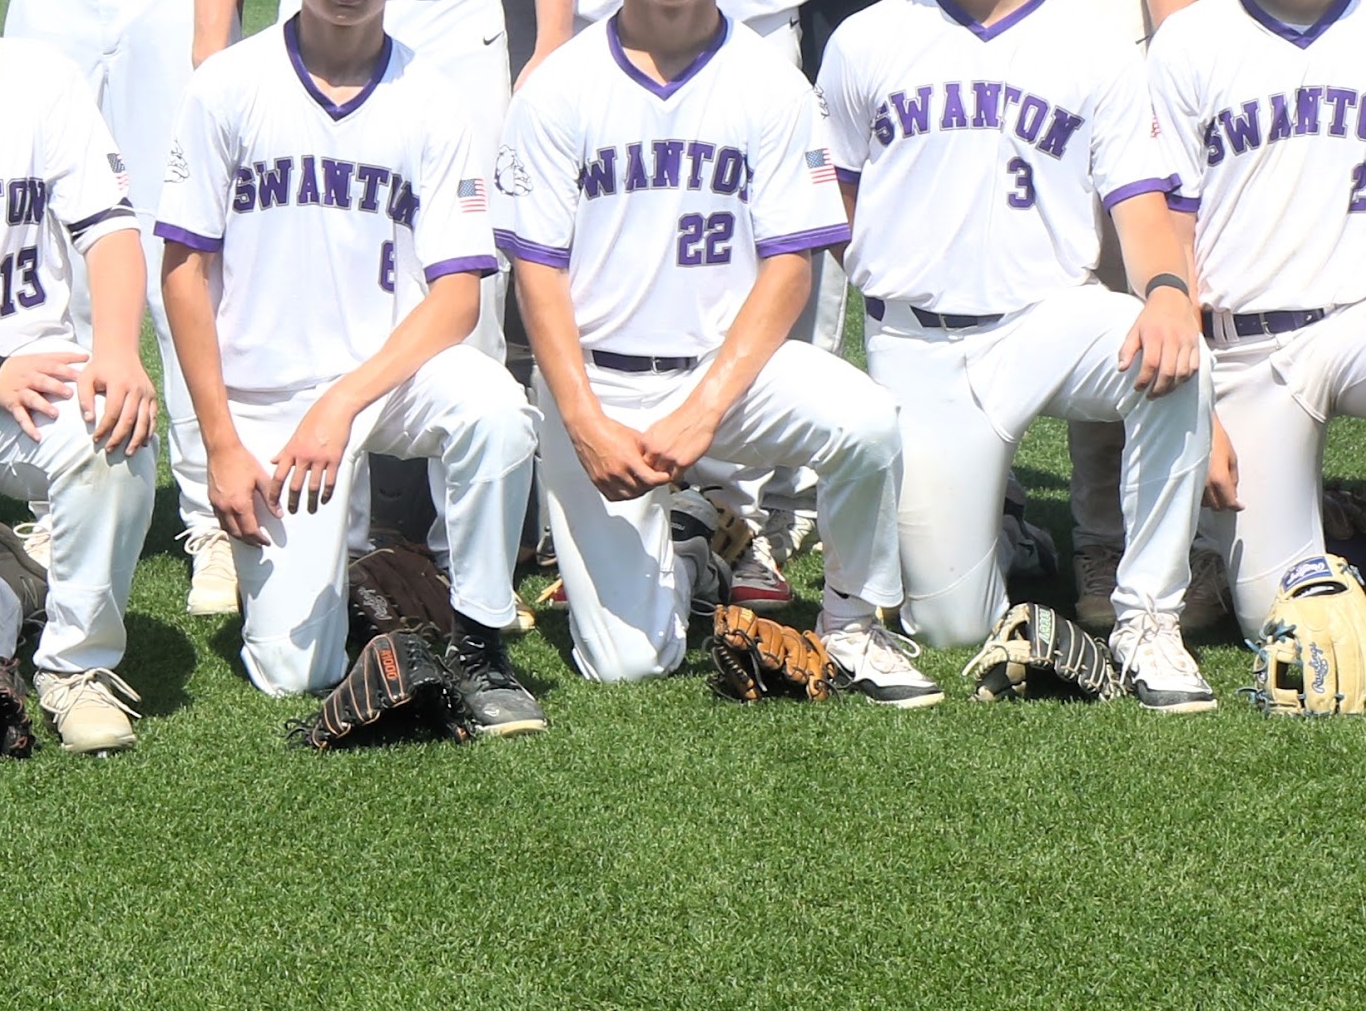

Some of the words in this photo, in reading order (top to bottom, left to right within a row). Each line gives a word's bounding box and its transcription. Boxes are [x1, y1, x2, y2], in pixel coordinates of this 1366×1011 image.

[578, 139, 753, 204] WANTO
[1005, 157, 1036, 211] 3
[676, 212, 736, 268] 22
